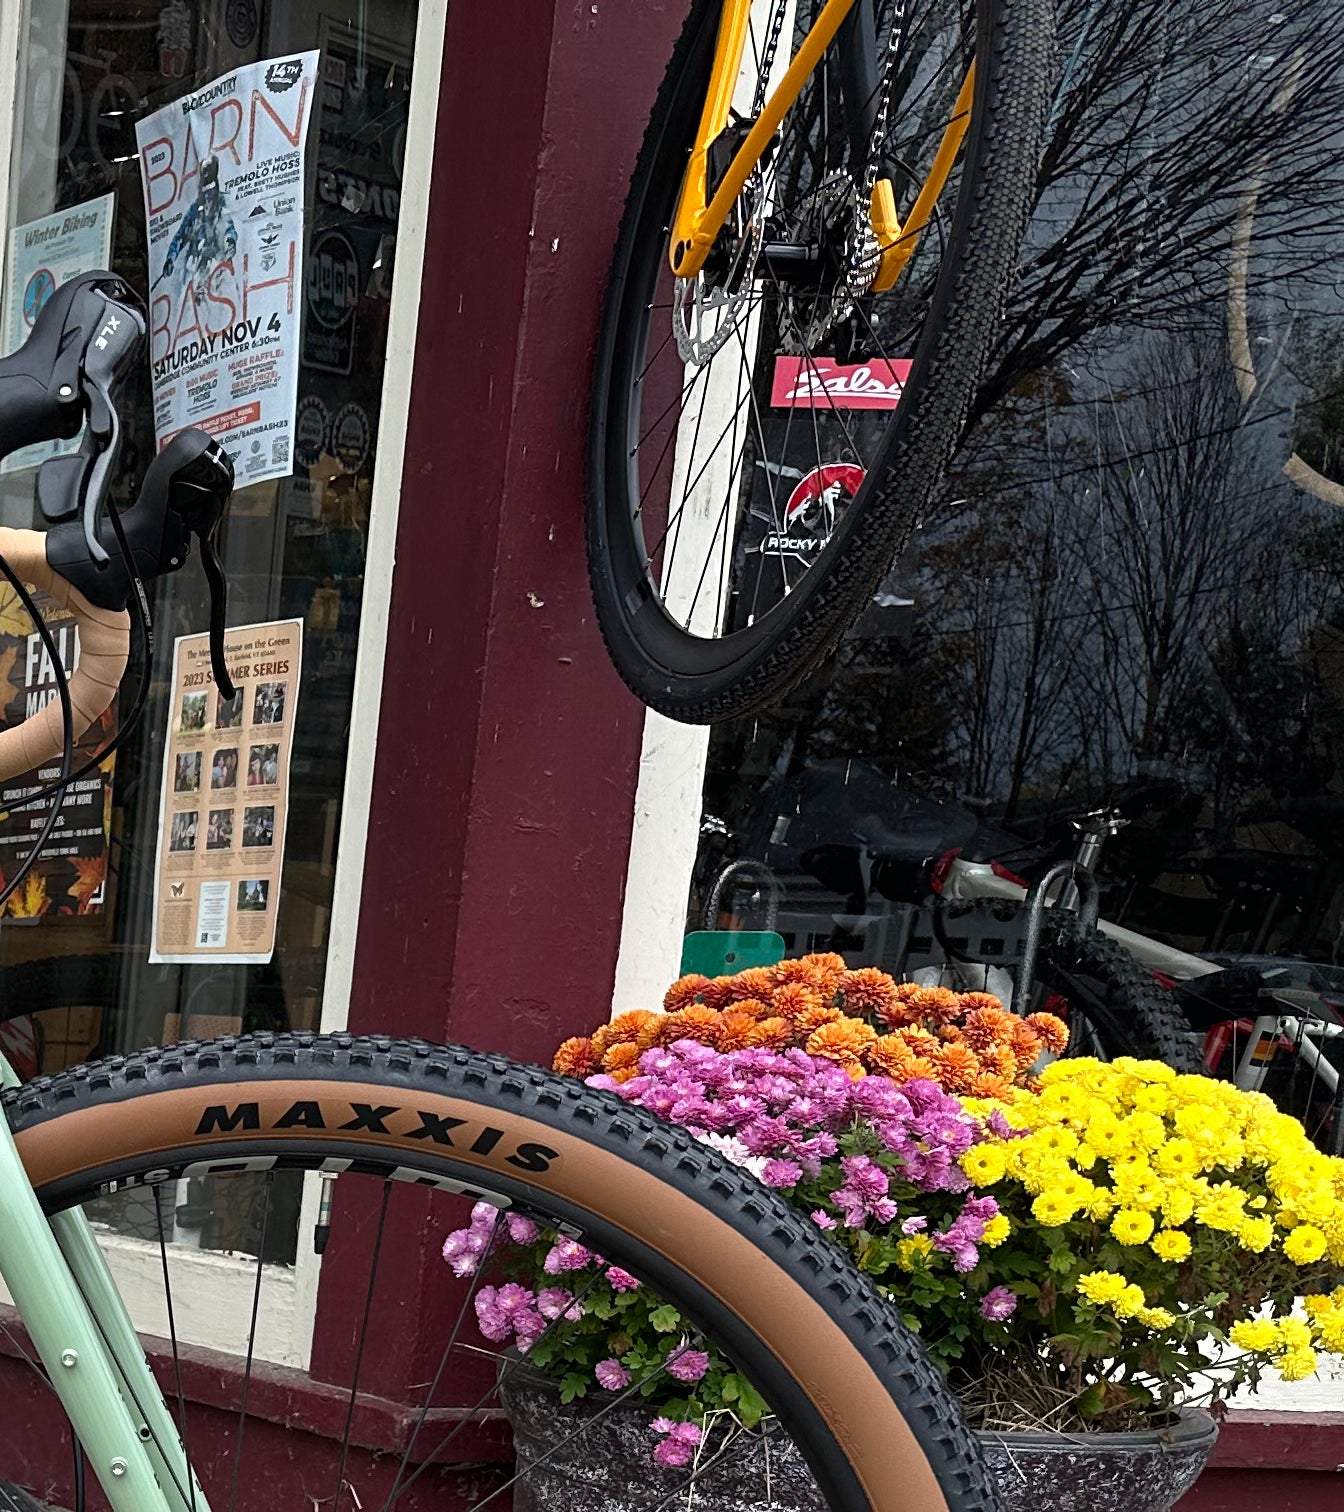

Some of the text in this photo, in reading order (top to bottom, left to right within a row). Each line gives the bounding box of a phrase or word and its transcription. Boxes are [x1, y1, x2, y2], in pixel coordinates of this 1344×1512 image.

[141, 76, 310, 217] BARN
[223, 157, 301, 192] TREMOLO HOSS
[24, 211, 99, 249] Winter Biking
[151, 240, 296, 369] BASH
[153, 332, 218, 381] SATURDAY
[221, 316, 263, 349] NOV
[266, 312, 282, 333] 4
[219, 342, 250, 360] CENTER
[767, 536, 817, 550] ROCKY
[254, 639, 267, 649] the
[267, 636, 291, 647] Green
[183, 660, 290, 688] 2023 SERIES
[193, 1100, 561, 1174] MAXXIS
